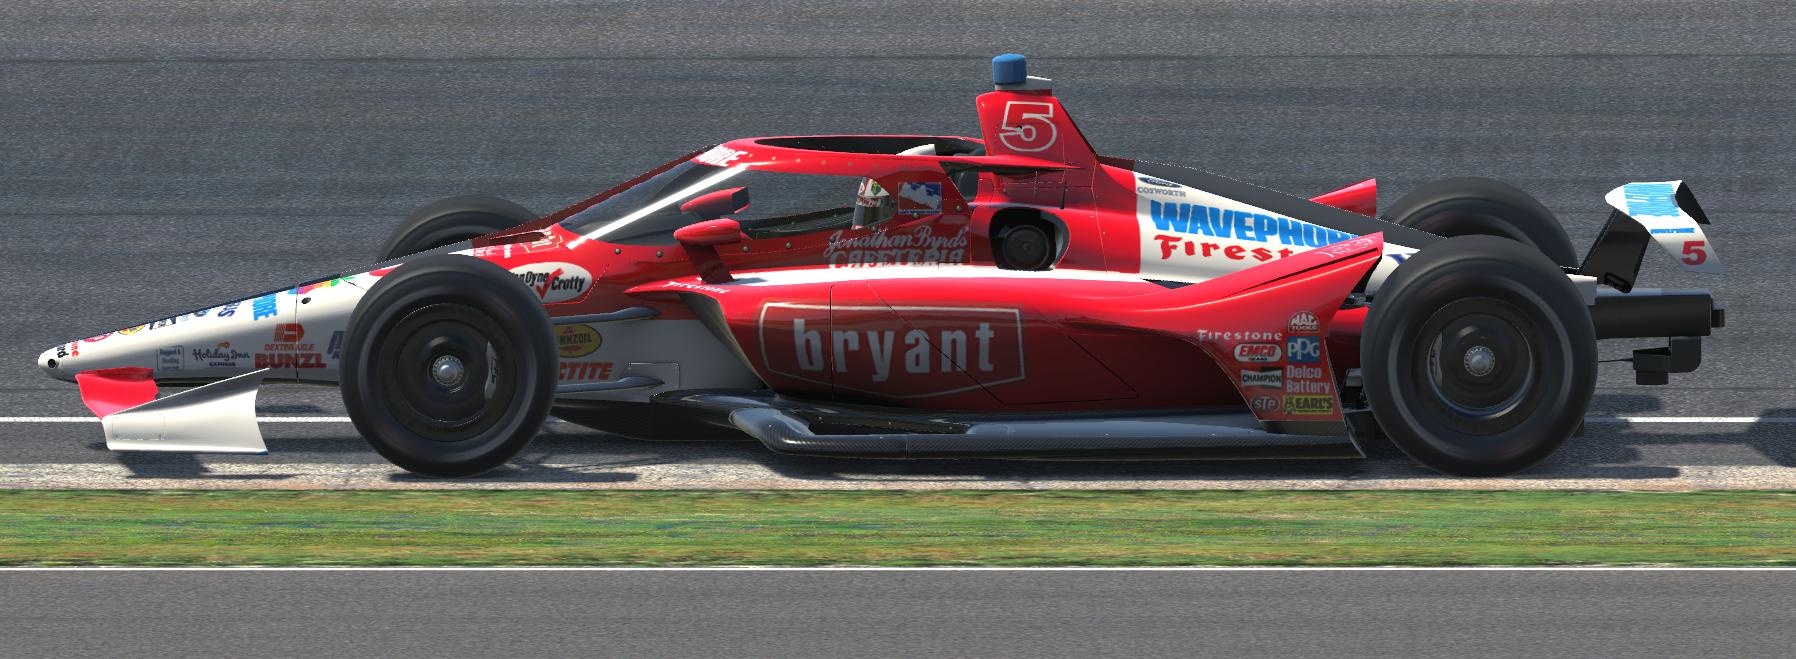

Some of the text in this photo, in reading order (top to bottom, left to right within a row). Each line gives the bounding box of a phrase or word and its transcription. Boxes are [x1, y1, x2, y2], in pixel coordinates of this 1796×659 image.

[999, 101, 1057, 152] 5
[1137, 186, 1186, 197] COSWORTH
[823, 230, 914, 257] Jonathan
[1154, 234, 1294, 262] Firest
[1681, 240, 1707, 266] 5
[525, 271, 550, 287] Dyne
[551, 275, 585, 292] Crotty
[1197, 329, 1283, 342] Firestone
[192, 348, 230, 361] Holiday
[230, 350, 250, 359] Inn
[793, 318, 995, 382] bryant
[1287, 338, 1320, 360] PPG
[255, 353, 327, 368] BUNZL
[559, 362, 614, 380] CTITE
[1242, 374, 1281, 383] CHAMPION
[1287, 365, 1322, 378] Delco
[1287, 379, 1330, 393] Battery
